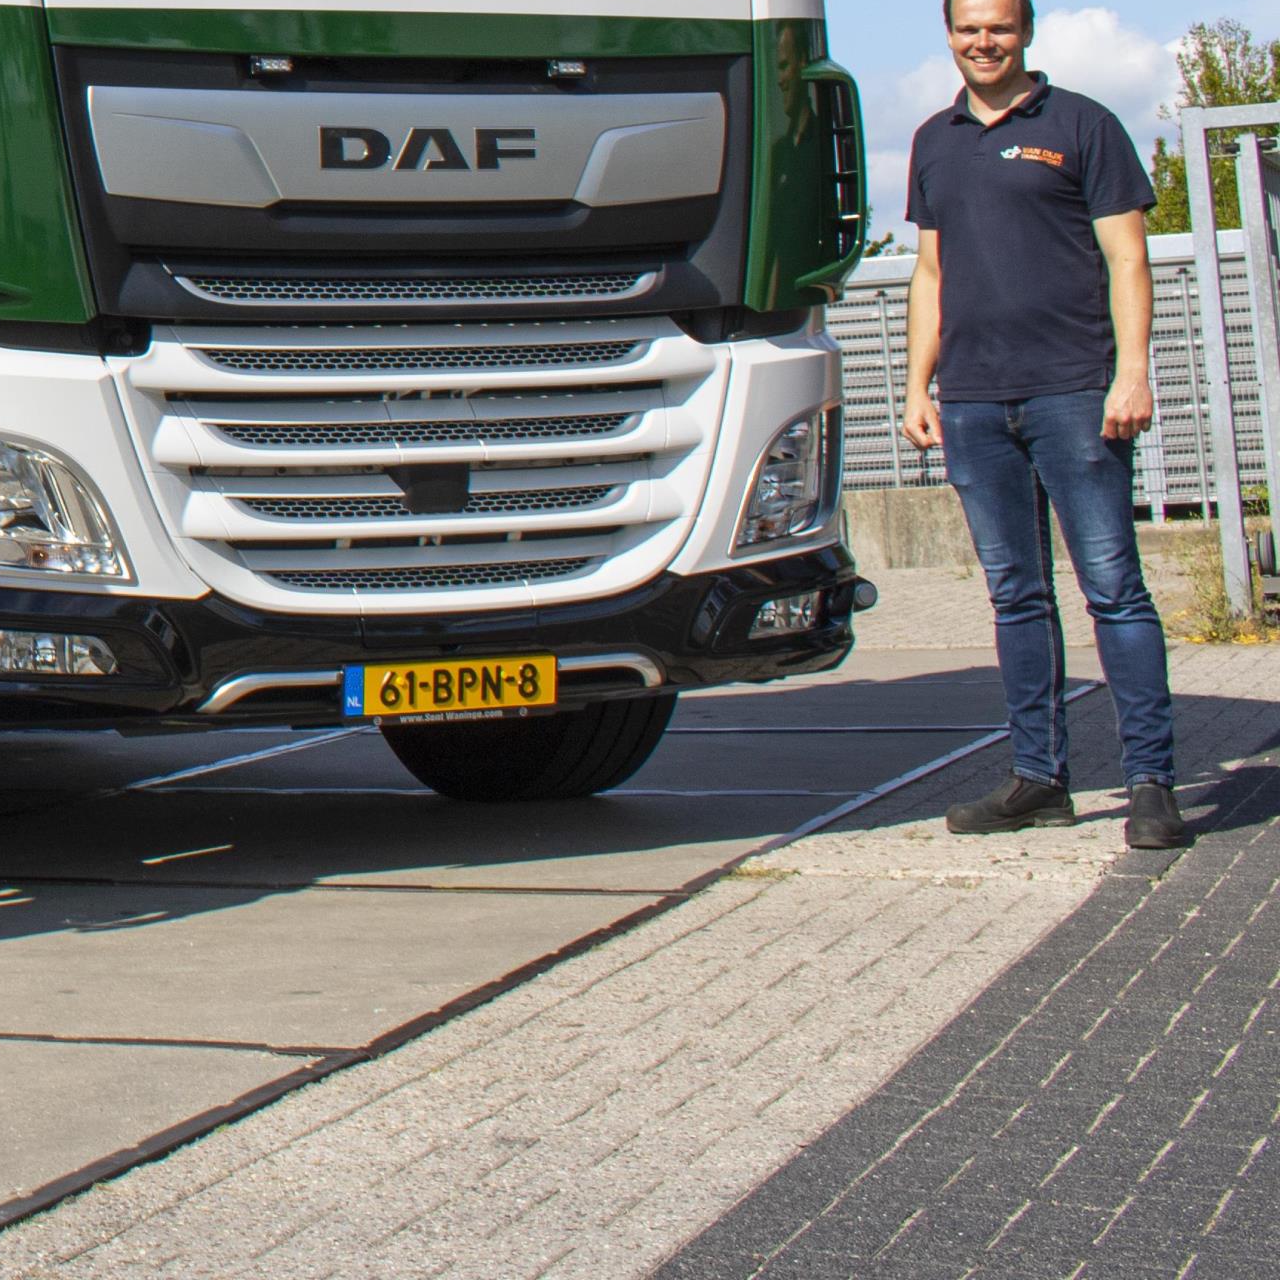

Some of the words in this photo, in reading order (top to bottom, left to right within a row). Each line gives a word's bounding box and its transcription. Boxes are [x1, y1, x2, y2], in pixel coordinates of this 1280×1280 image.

[318, 126, 537, 171] DAF
[347, 696, 362, 708] NL
[379, 663, 539, 707] 61-BPN-8
